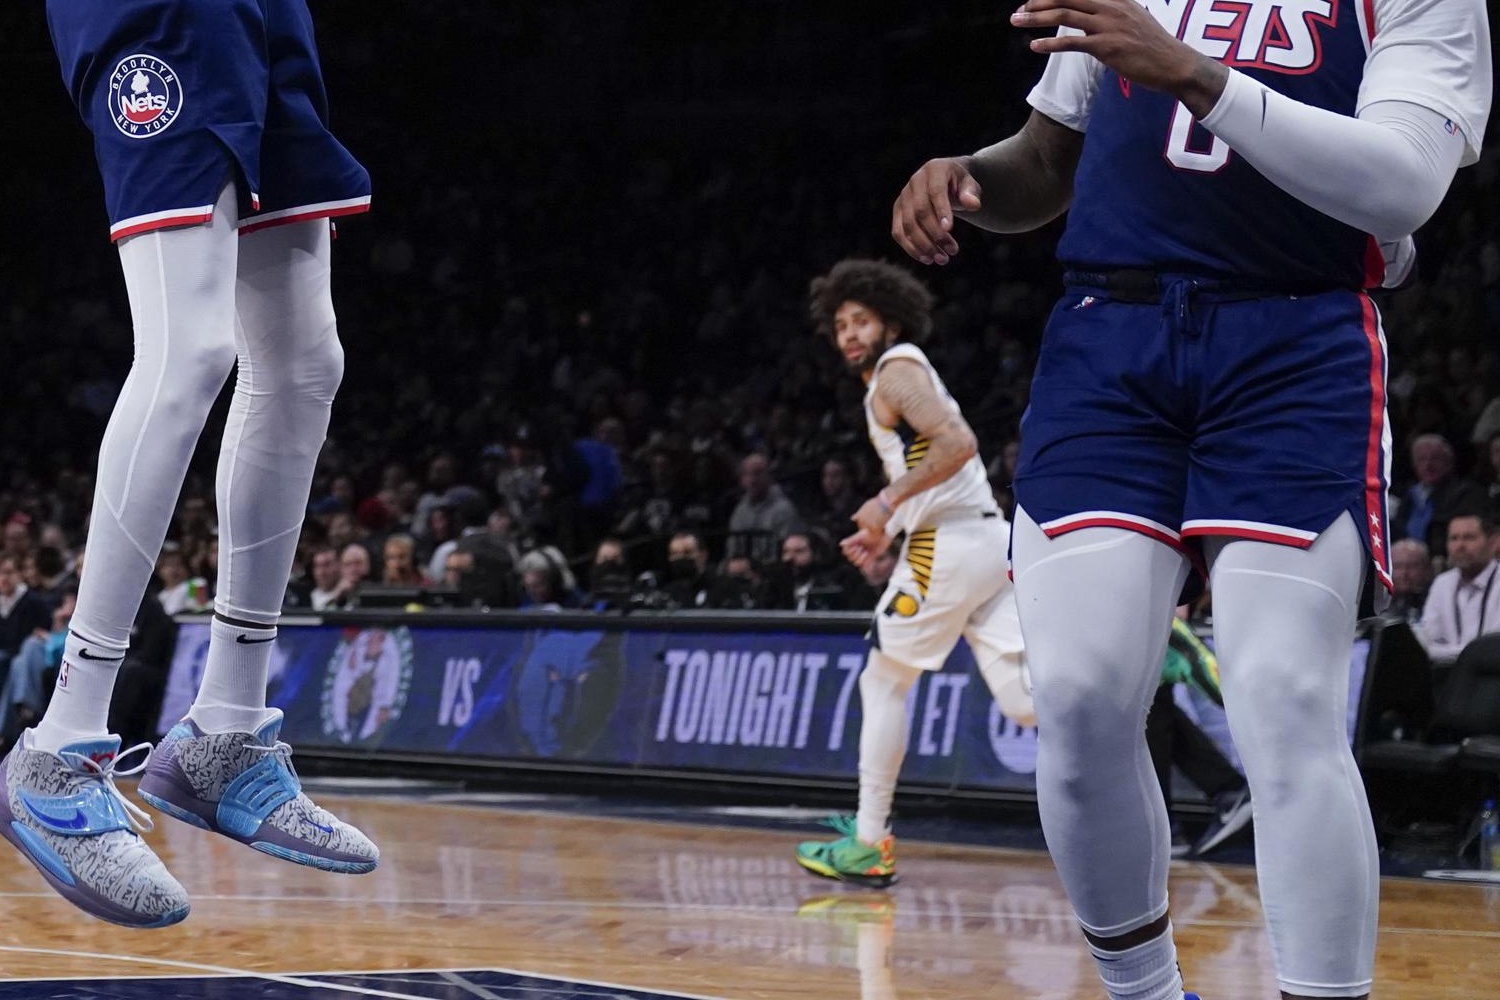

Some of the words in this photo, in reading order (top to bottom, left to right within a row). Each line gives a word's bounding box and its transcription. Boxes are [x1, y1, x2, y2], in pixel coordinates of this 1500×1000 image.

[112, 58, 174, 90] BROOKLYN
[121, 92, 166, 115] Nets
[116, 114, 139, 134] NEW
[145, 107, 175, 133] YORK
[437, 657, 481, 727] VS
[655, 649, 829, 750] TONIGHT
[827, 653, 864, 751] 7
[917, 673, 970, 757] ET
